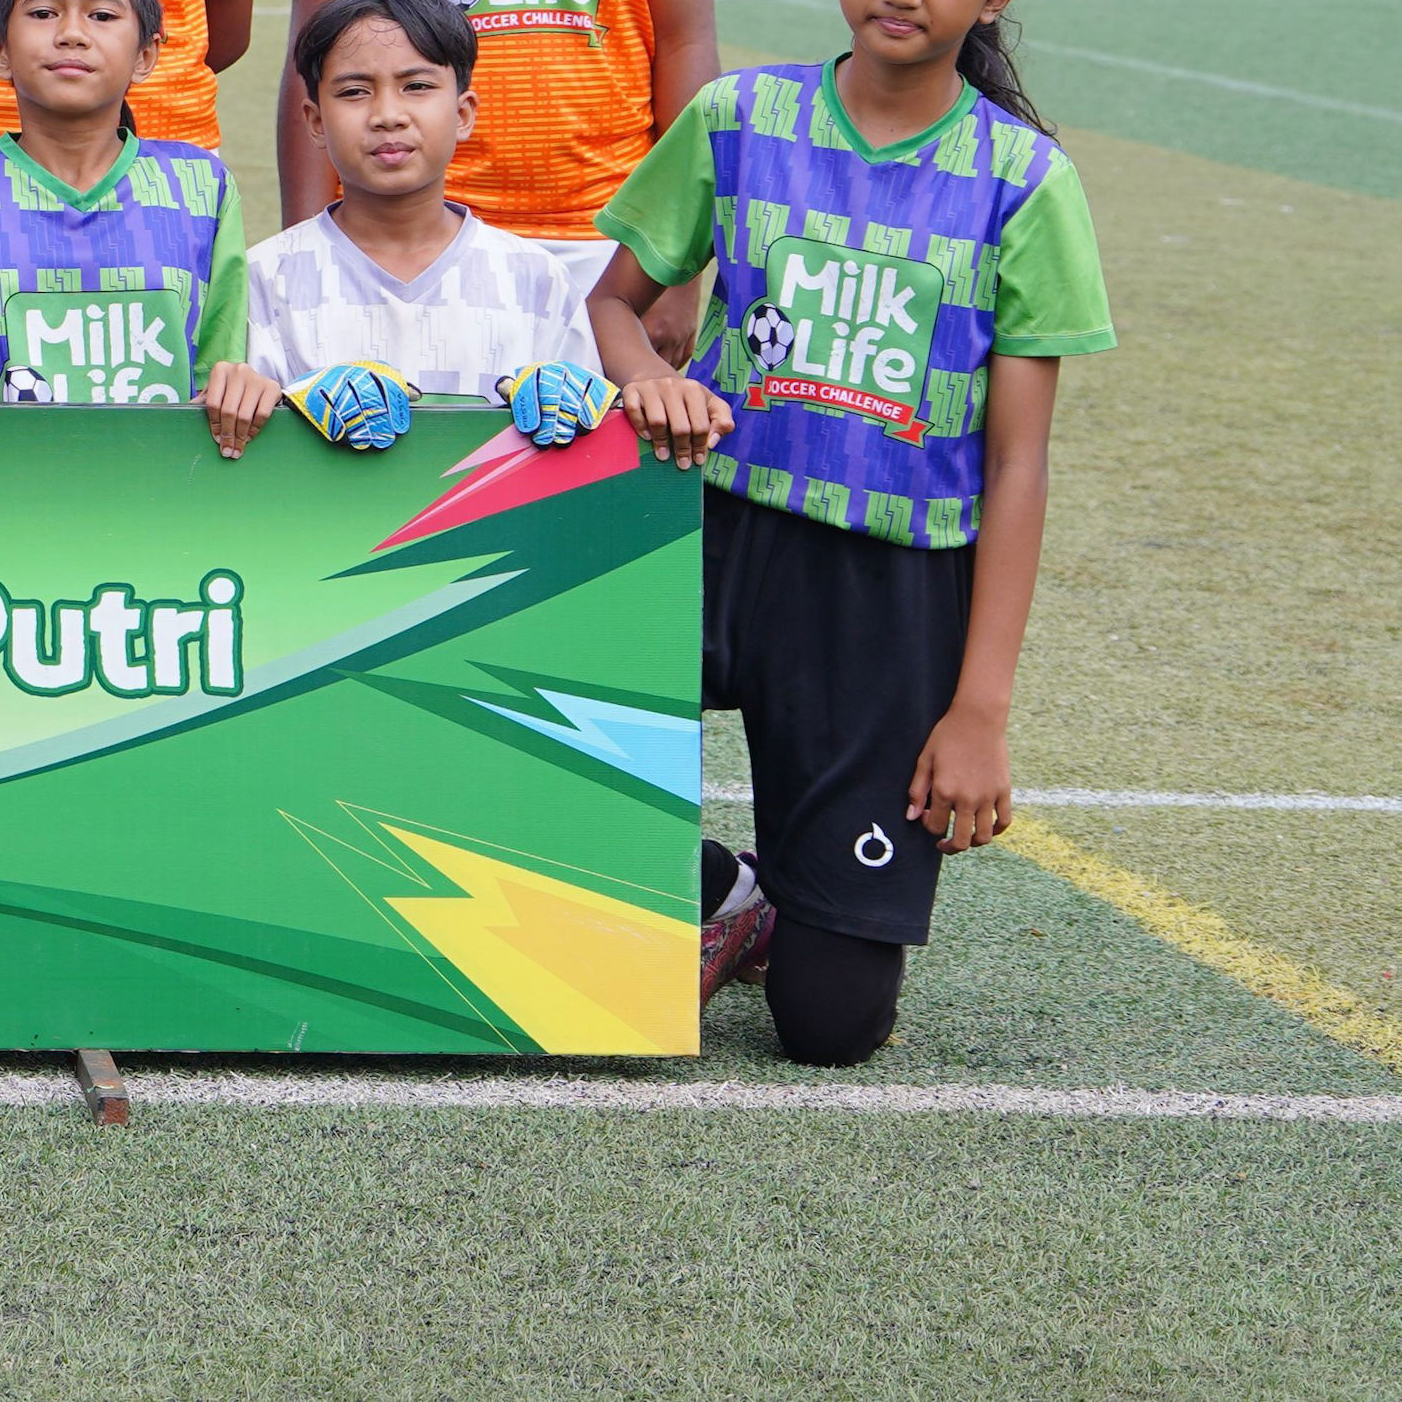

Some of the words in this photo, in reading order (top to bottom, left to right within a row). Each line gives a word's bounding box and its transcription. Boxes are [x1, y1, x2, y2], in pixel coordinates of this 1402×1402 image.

[471, 11, 519, 31] OCCER
[522, 12, 593, 29] CHALLENG
[779, 253, 919, 335] Milk
[25, 302, 174, 368] Milk
[792, 319, 917, 394] Life
[819, 386, 903, 419] CHALLENGE
